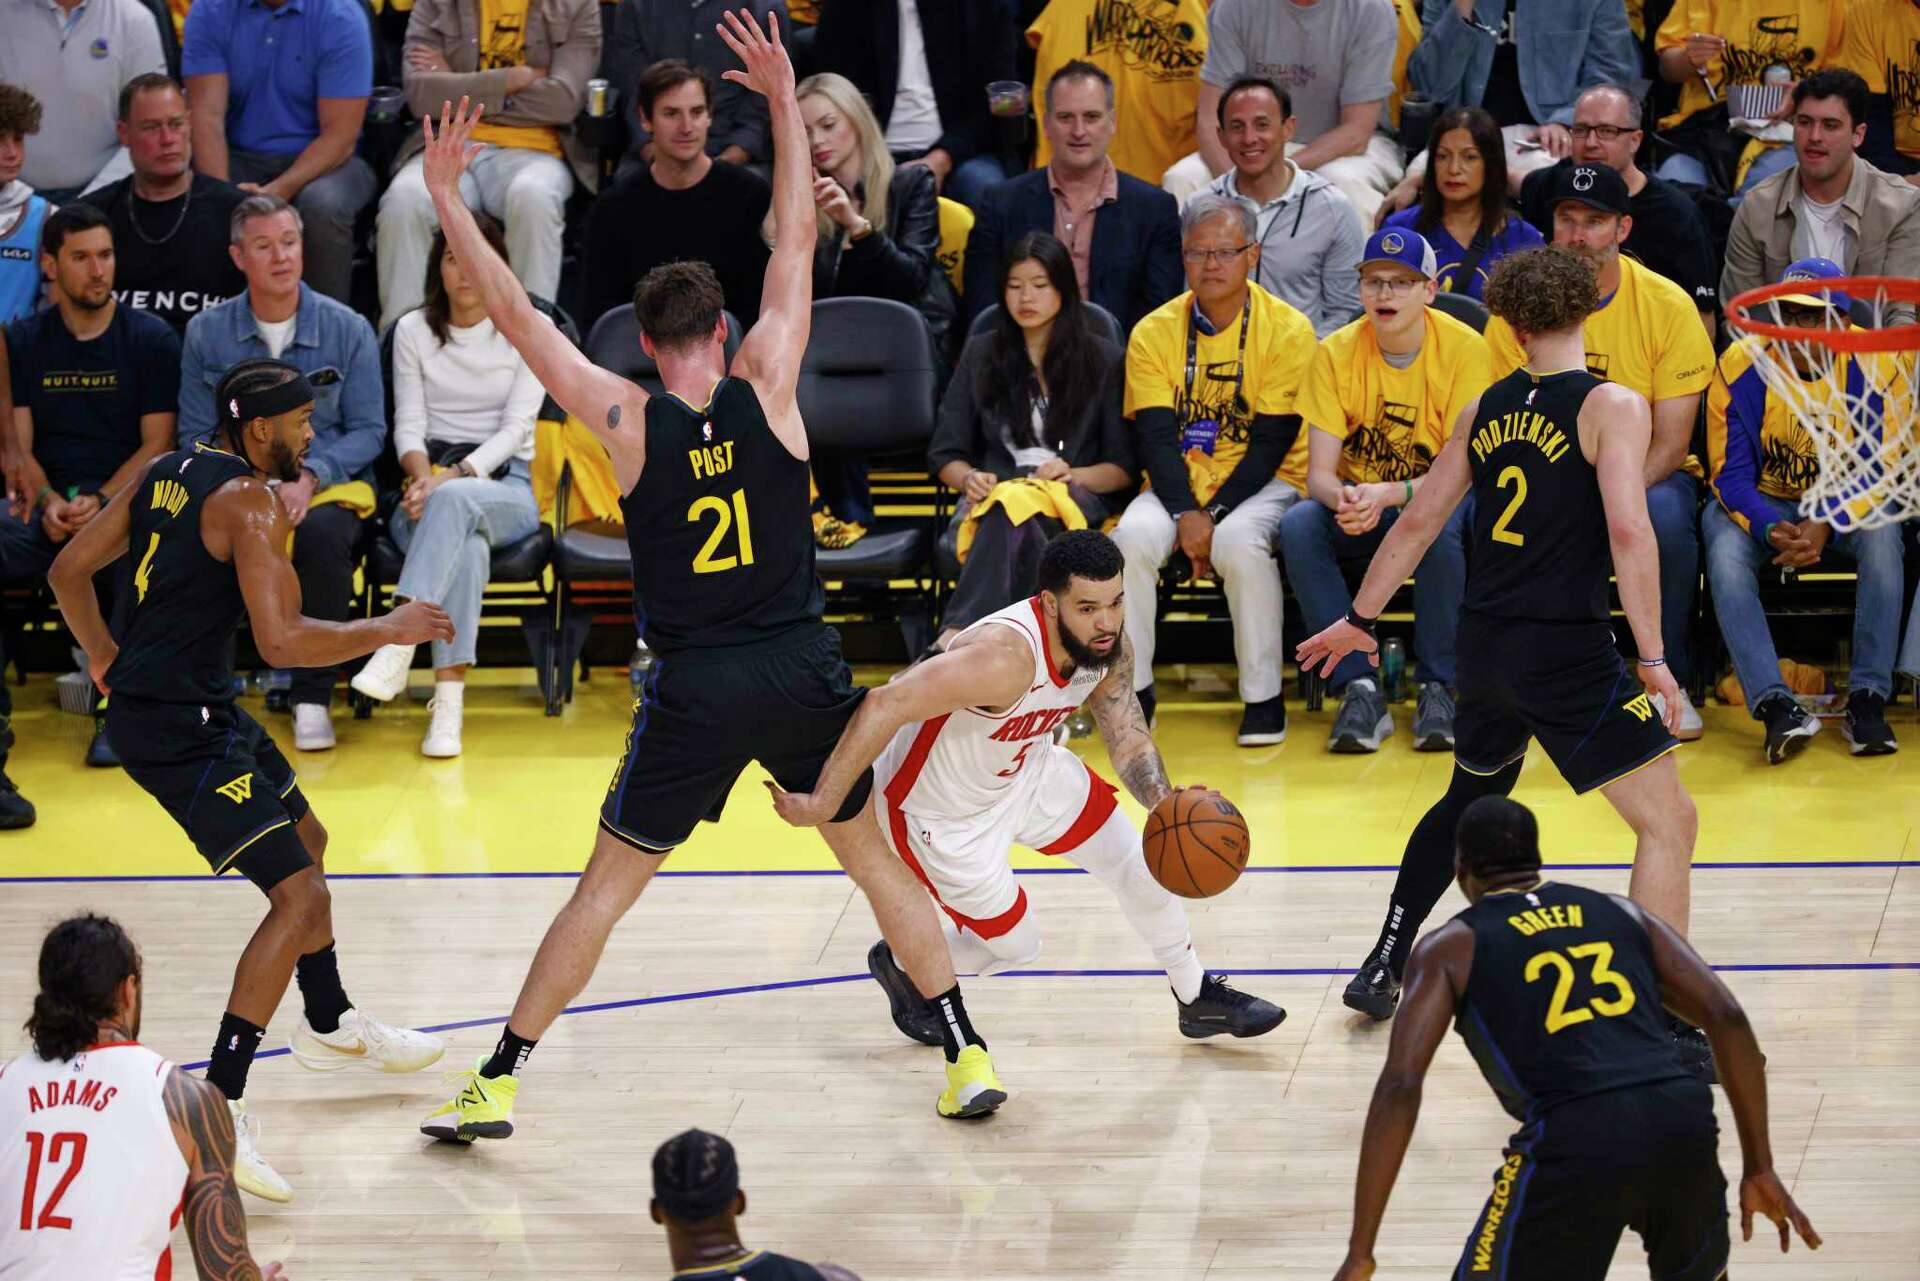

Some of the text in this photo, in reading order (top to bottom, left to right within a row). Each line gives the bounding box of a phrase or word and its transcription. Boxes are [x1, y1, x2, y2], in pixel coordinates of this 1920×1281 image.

[110, 289, 228, 312] VENCH
[1676, 365, 1707, 380] ORACLE
[688, 440, 735, 480] POST
[1471, 411, 1571, 464] PODZIEMSKI
[1491, 465, 1528, 547] 2
[687, 488, 755, 574] 21
[996, 741, 1034, 777] 5
[1507, 904, 1583, 936] GREEN
[1524, 941, 1636, 1035] 23
[28, 1079, 118, 1113] ADAMS
[20, 1131, 88, 1231] 12
[1471, 1153, 1523, 1272] WARRIORS
